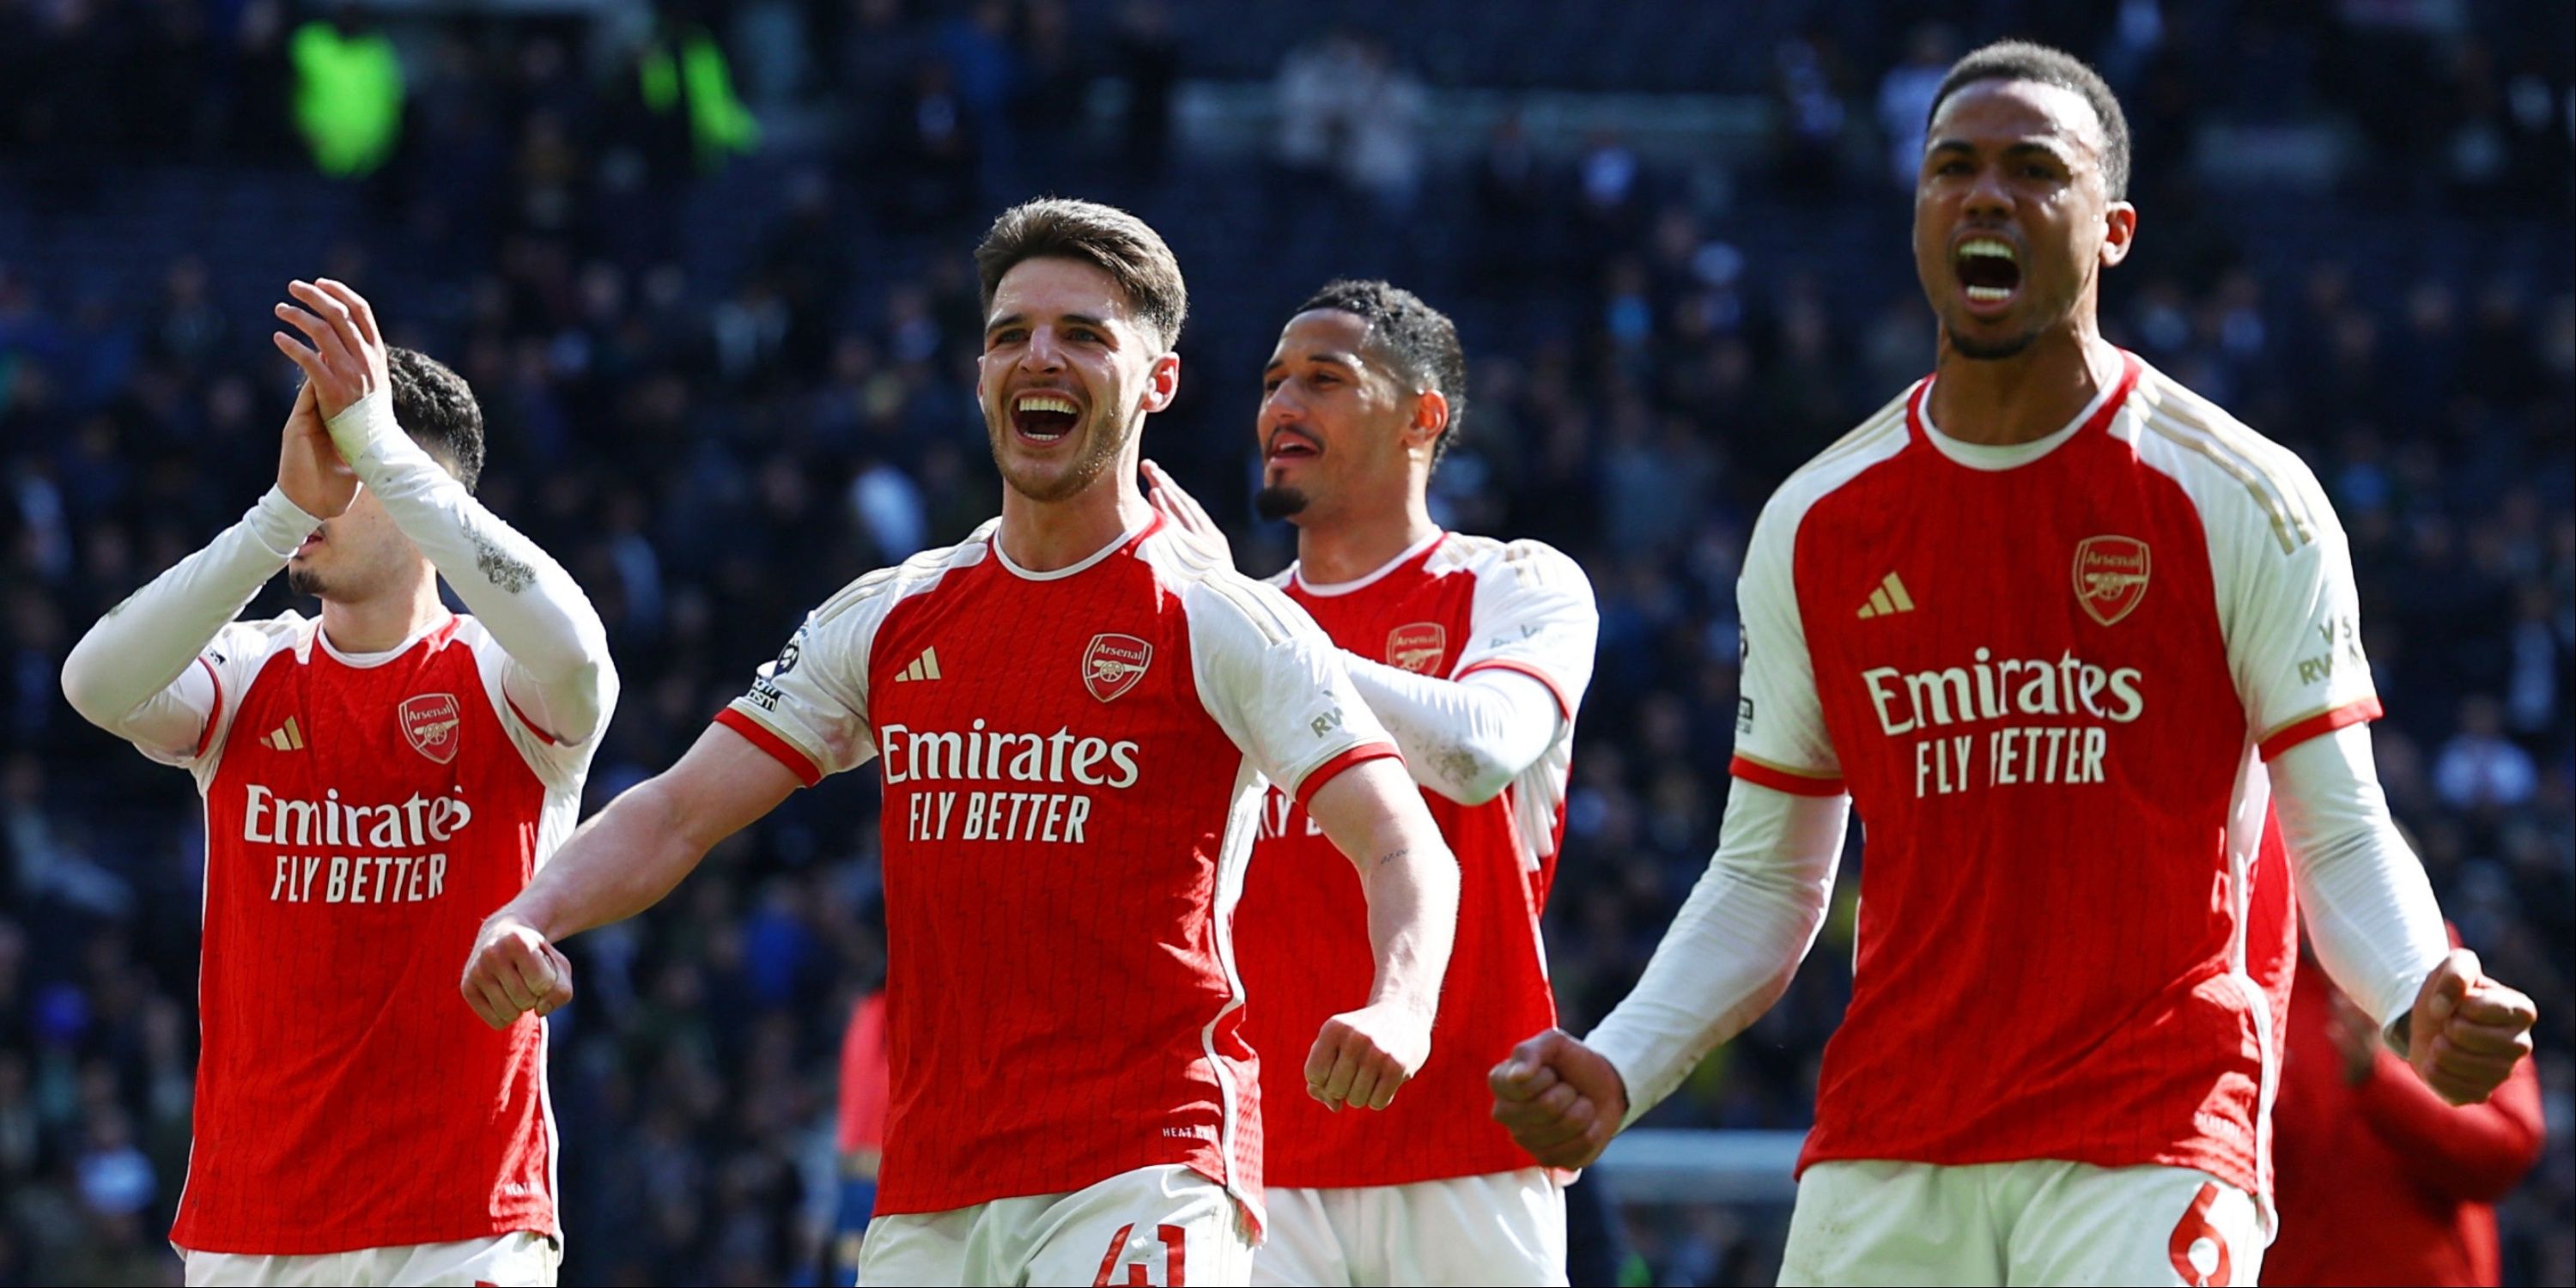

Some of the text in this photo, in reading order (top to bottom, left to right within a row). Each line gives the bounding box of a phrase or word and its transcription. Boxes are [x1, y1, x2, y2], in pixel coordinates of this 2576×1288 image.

[1096, 643, 1142, 660] Arsenal
[409, 704, 452, 722] Arsenal
[1862, 647, 2143, 736] Emirates
[881, 718, 1139, 788] Emirates
[1916, 735, 1972, 799] FLY
[244, 783, 471, 848] Emirates
[908, 792, 1091, 843] FLY BETTER
[270, 854, 447, 903] FLY BETTER
[1091, 1223, 1186, 1287] 41
[2168, 1181, 2231, 1287] 6
